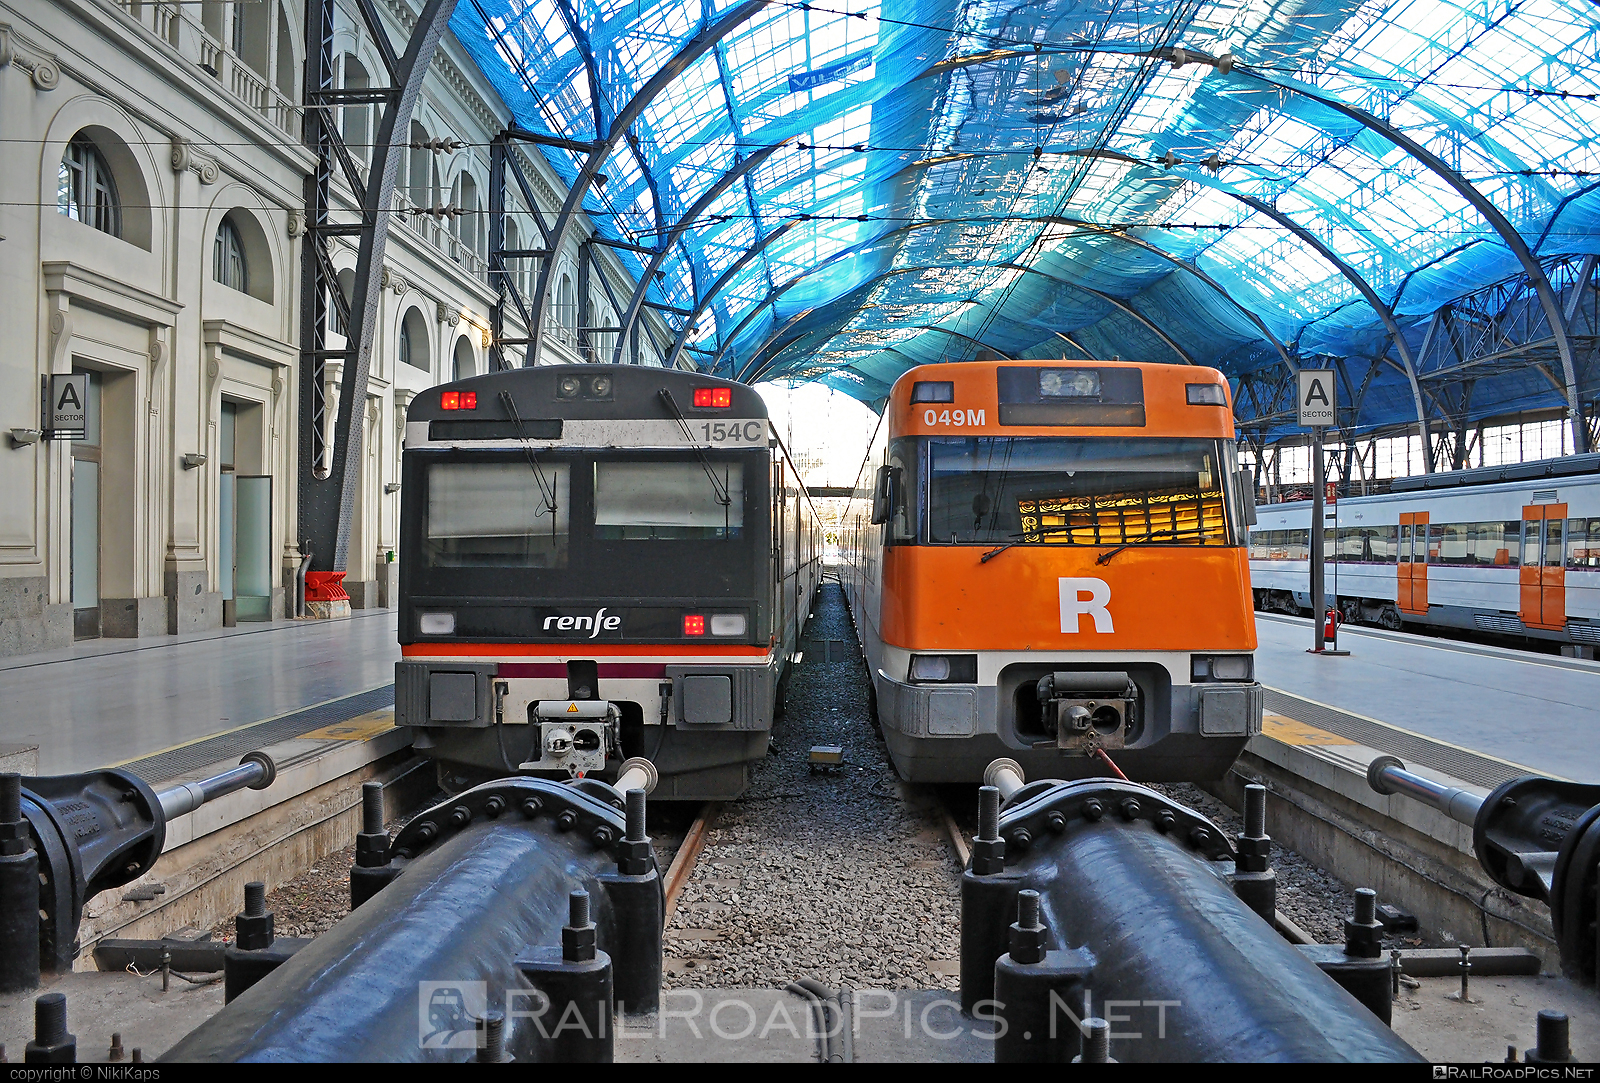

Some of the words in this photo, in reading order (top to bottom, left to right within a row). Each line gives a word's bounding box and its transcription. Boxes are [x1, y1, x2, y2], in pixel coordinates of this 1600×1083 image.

[57, 382, 81, 410] A
[1305, 378, 1329, 406] A
[924, 409, 986, 426] 049M
[1302, 410, 1333, 418] SECTOR
[701, 421, 761, 441] 154C
[1058, 577, 1115, 633] R
[543, 607, 621, 639] renfe
